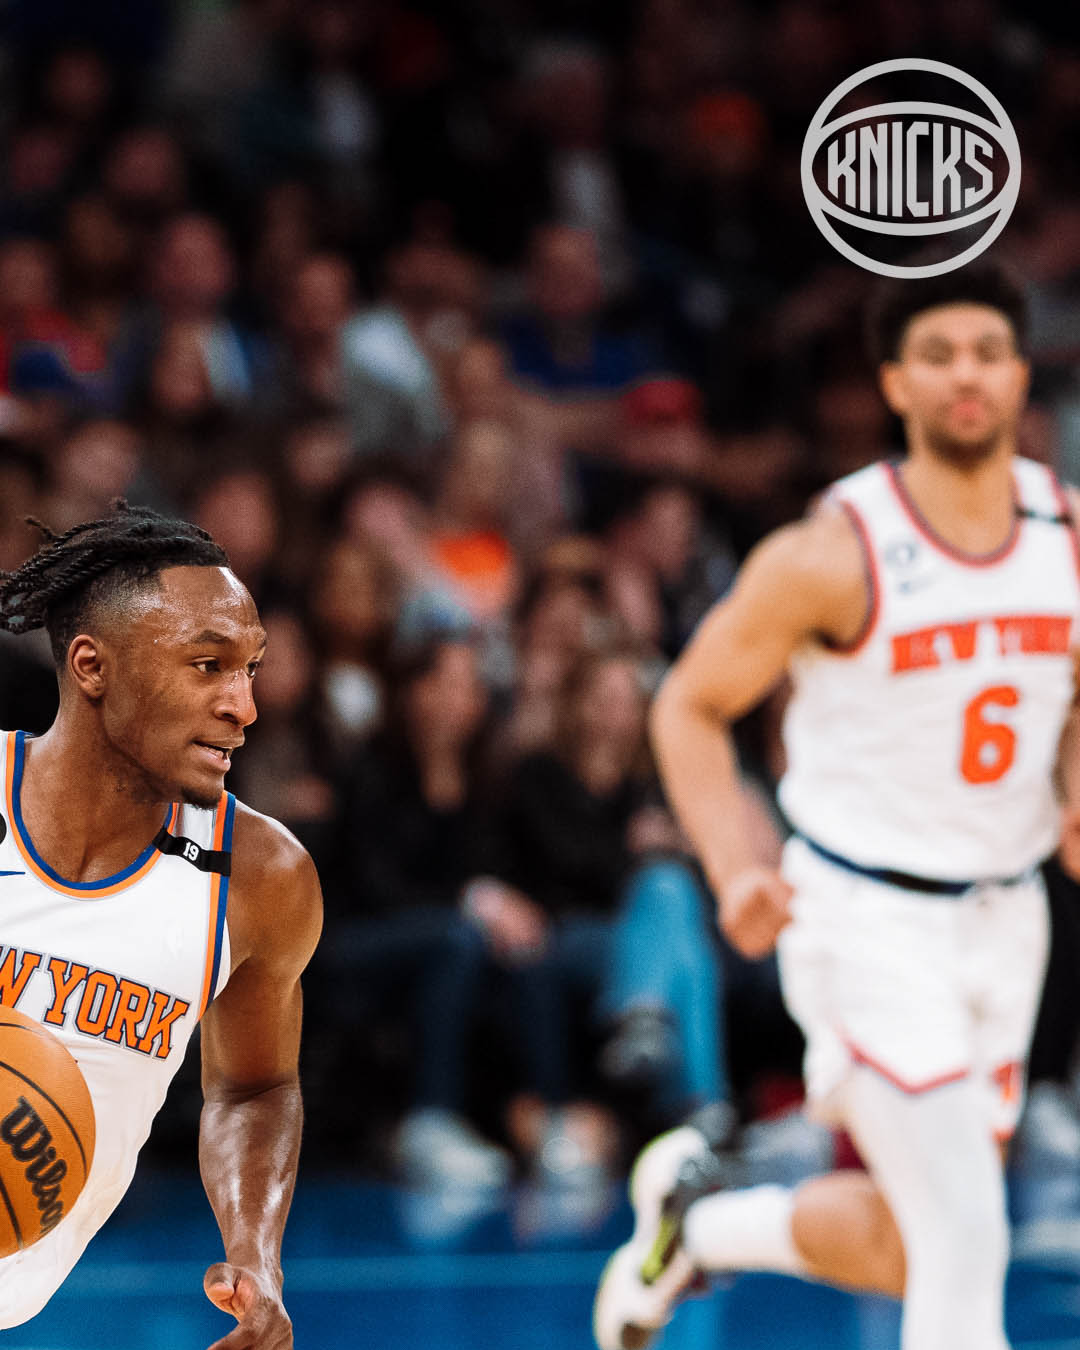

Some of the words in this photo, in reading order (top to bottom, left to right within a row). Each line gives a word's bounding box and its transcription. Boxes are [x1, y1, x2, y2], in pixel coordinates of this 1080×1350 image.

[959, 685, 1019, 784] 6
[183, 841, 199, 862] 19
[43, 957, 191, 1060] YORK
